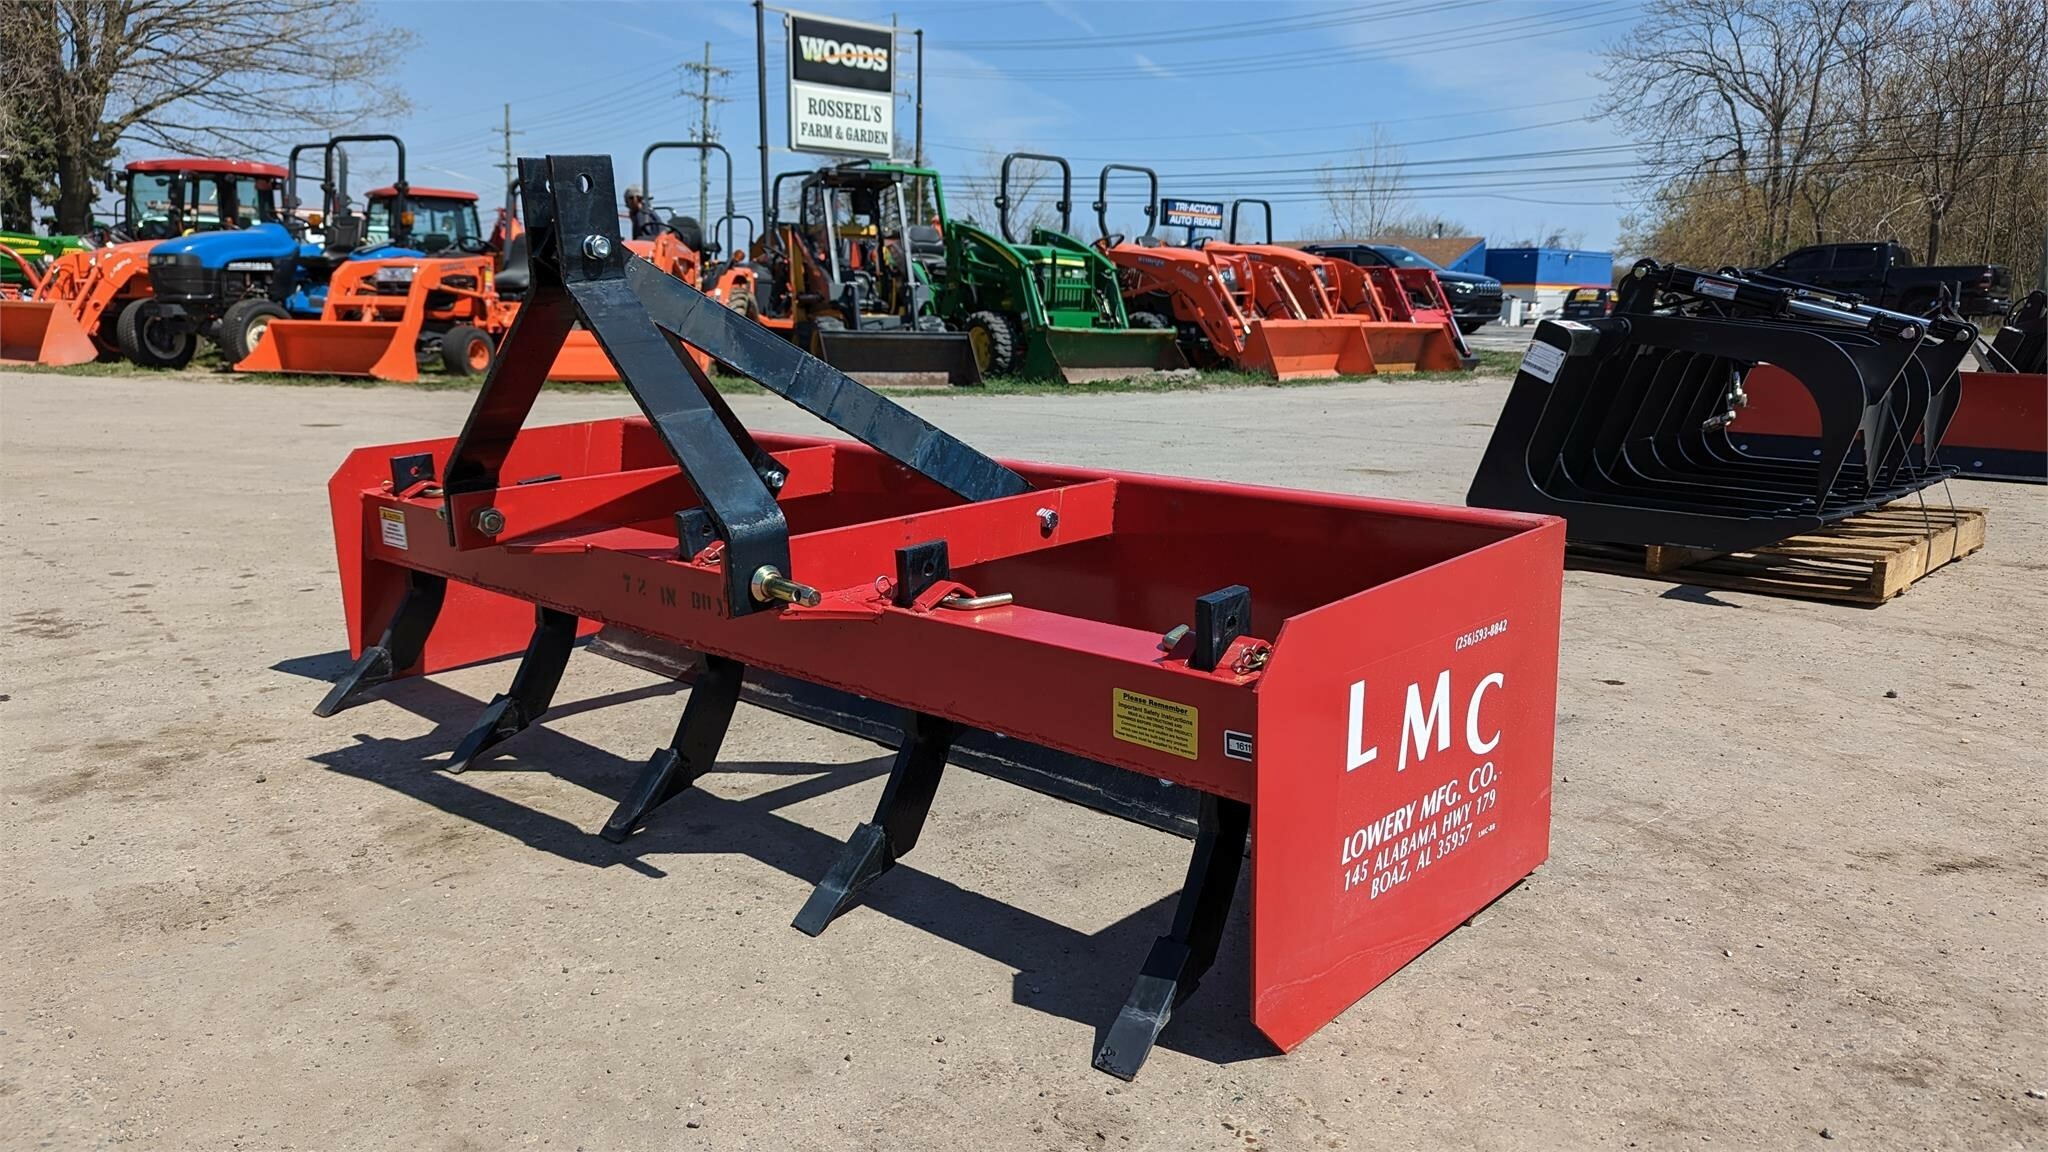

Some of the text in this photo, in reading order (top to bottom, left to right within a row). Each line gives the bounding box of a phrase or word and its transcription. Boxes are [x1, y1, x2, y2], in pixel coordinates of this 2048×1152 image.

[799, 35, 888, 72] WOODS
[808, 97, 882, 123] ROSSEEL'S
[800, 122, 888, 145] FARM & GARDEN
[1169, 216, 1221, 227] AUTO REPAIR
[1175, 202, 1217, 214] TRI-ACTION
[1455, 618, 1508, 652] (256)593-8842
[1123, 693, 1187, 715] Please Remember
[1341, 761, 1498, 865] LOWERY MFG. CO.
[1344, 789, 1496, 891] 145 ALABAMA HWY 179
[1370, 822, 1473, 900] BOAZ, AL 35957
